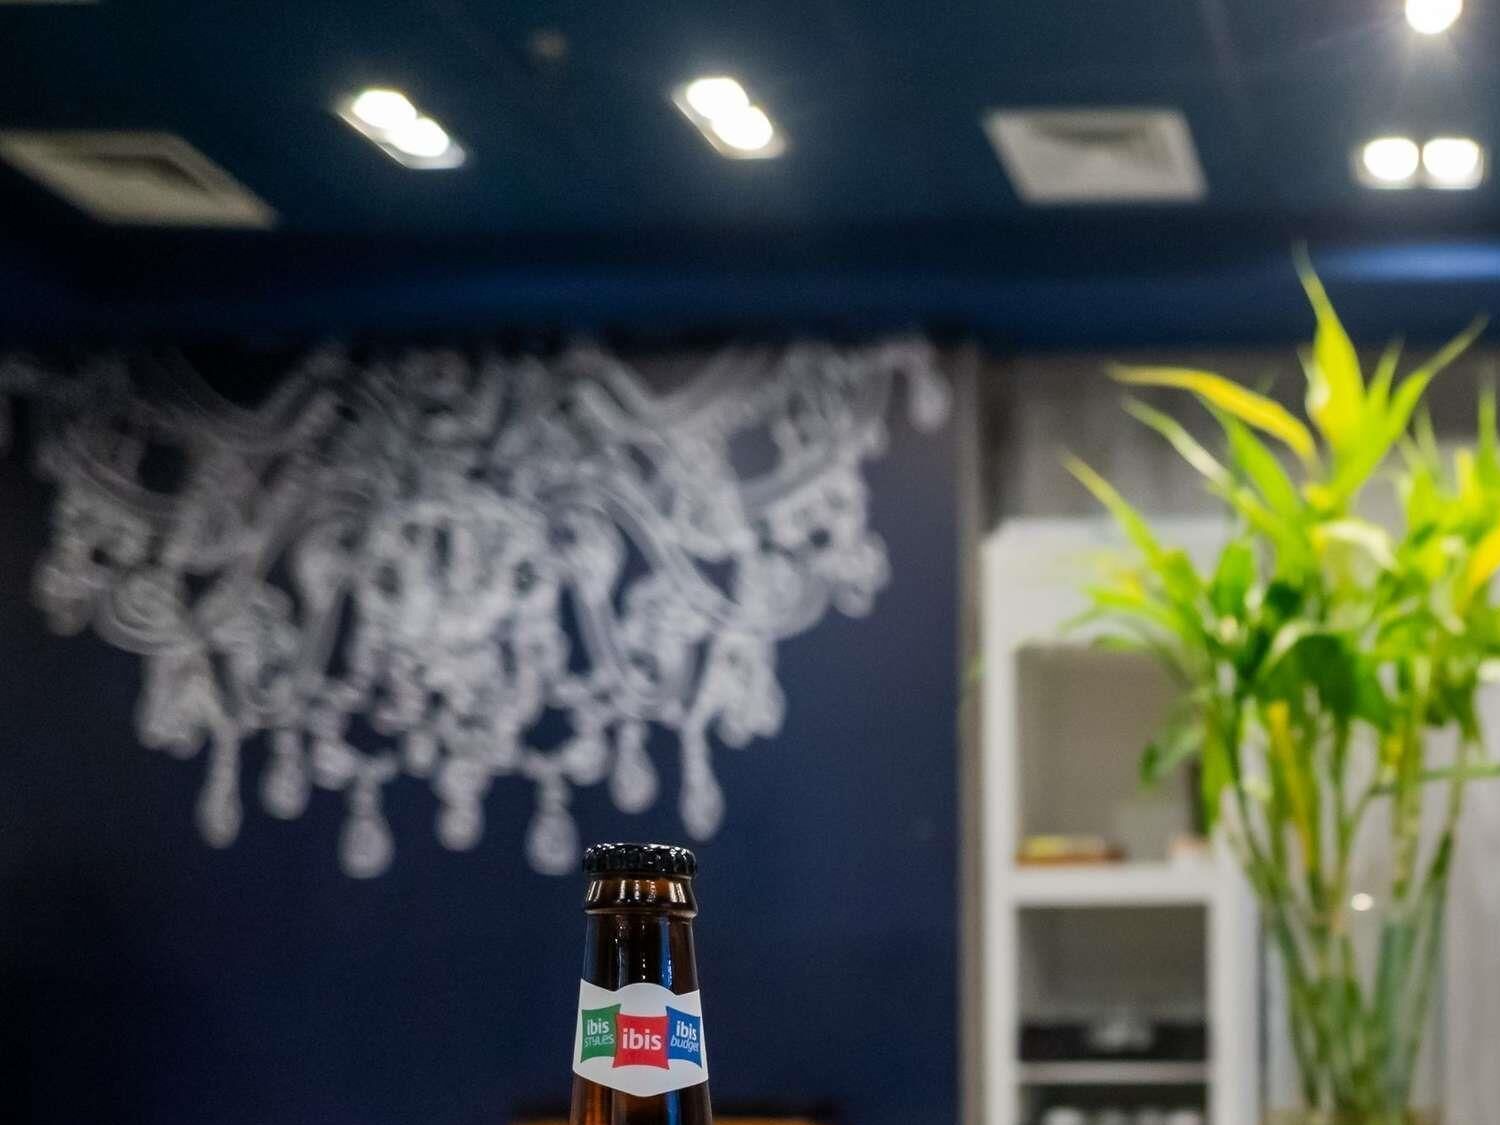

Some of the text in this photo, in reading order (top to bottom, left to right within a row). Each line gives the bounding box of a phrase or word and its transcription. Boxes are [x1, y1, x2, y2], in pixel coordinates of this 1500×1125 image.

[586, 1017, 609, 1036] ibis
[675, 1020, 697, 1041] ibis
[622, 1028, 663, 1051] ibis
